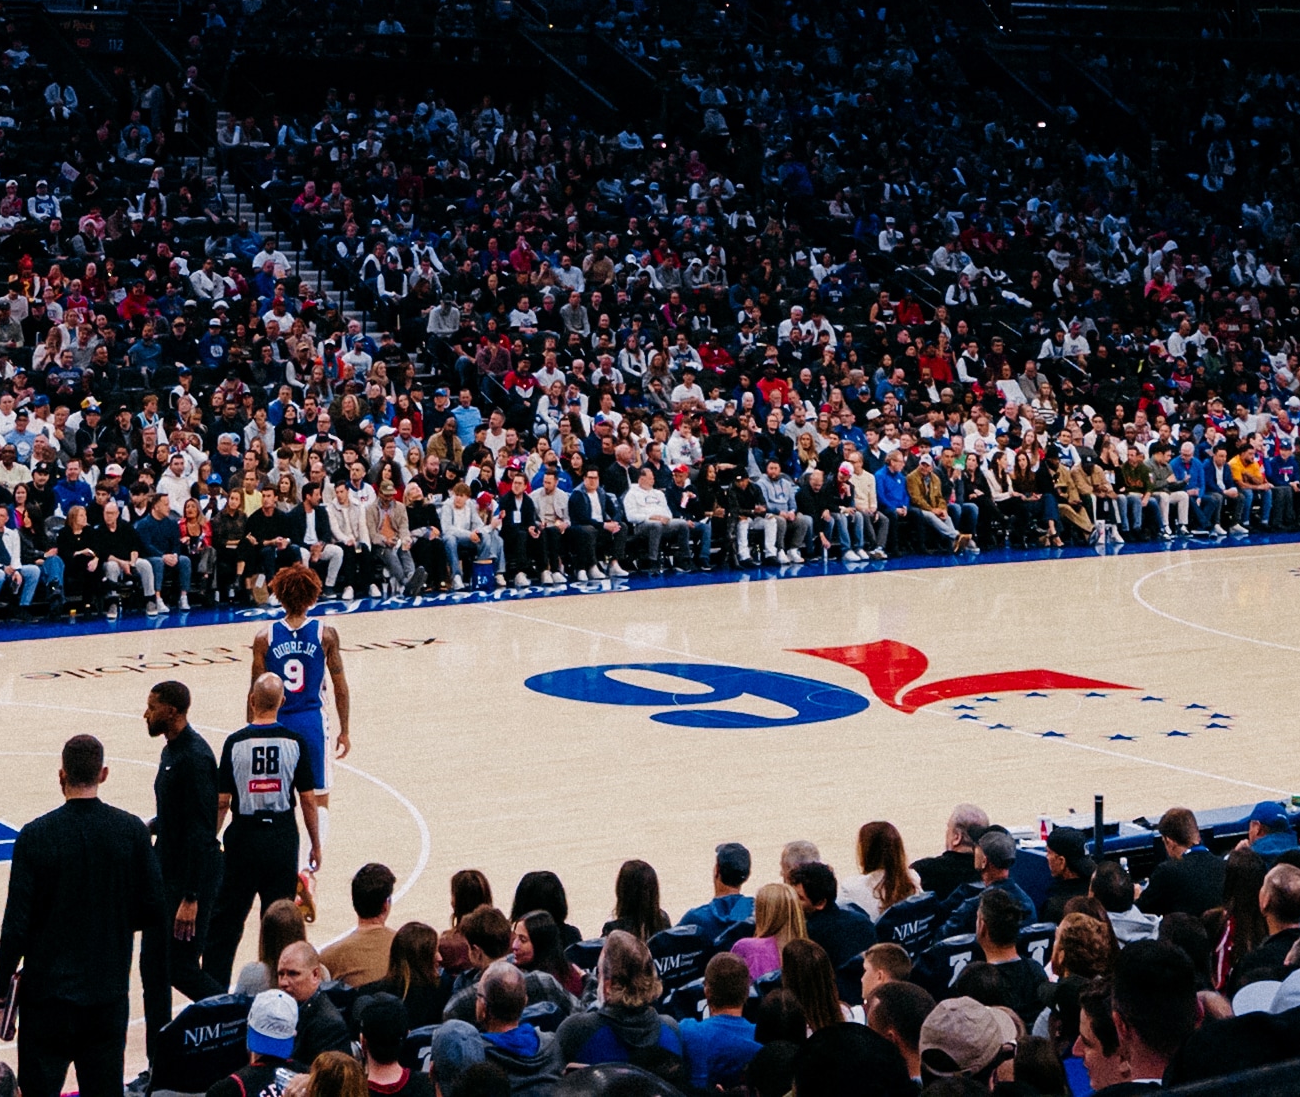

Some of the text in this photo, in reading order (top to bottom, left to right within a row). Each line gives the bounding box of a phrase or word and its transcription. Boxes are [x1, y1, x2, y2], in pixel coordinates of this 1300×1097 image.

[283, 658, 305, 693] 9
[252, 746, 279, 775] 68
[184, 1022, 221, 1047] NJM
